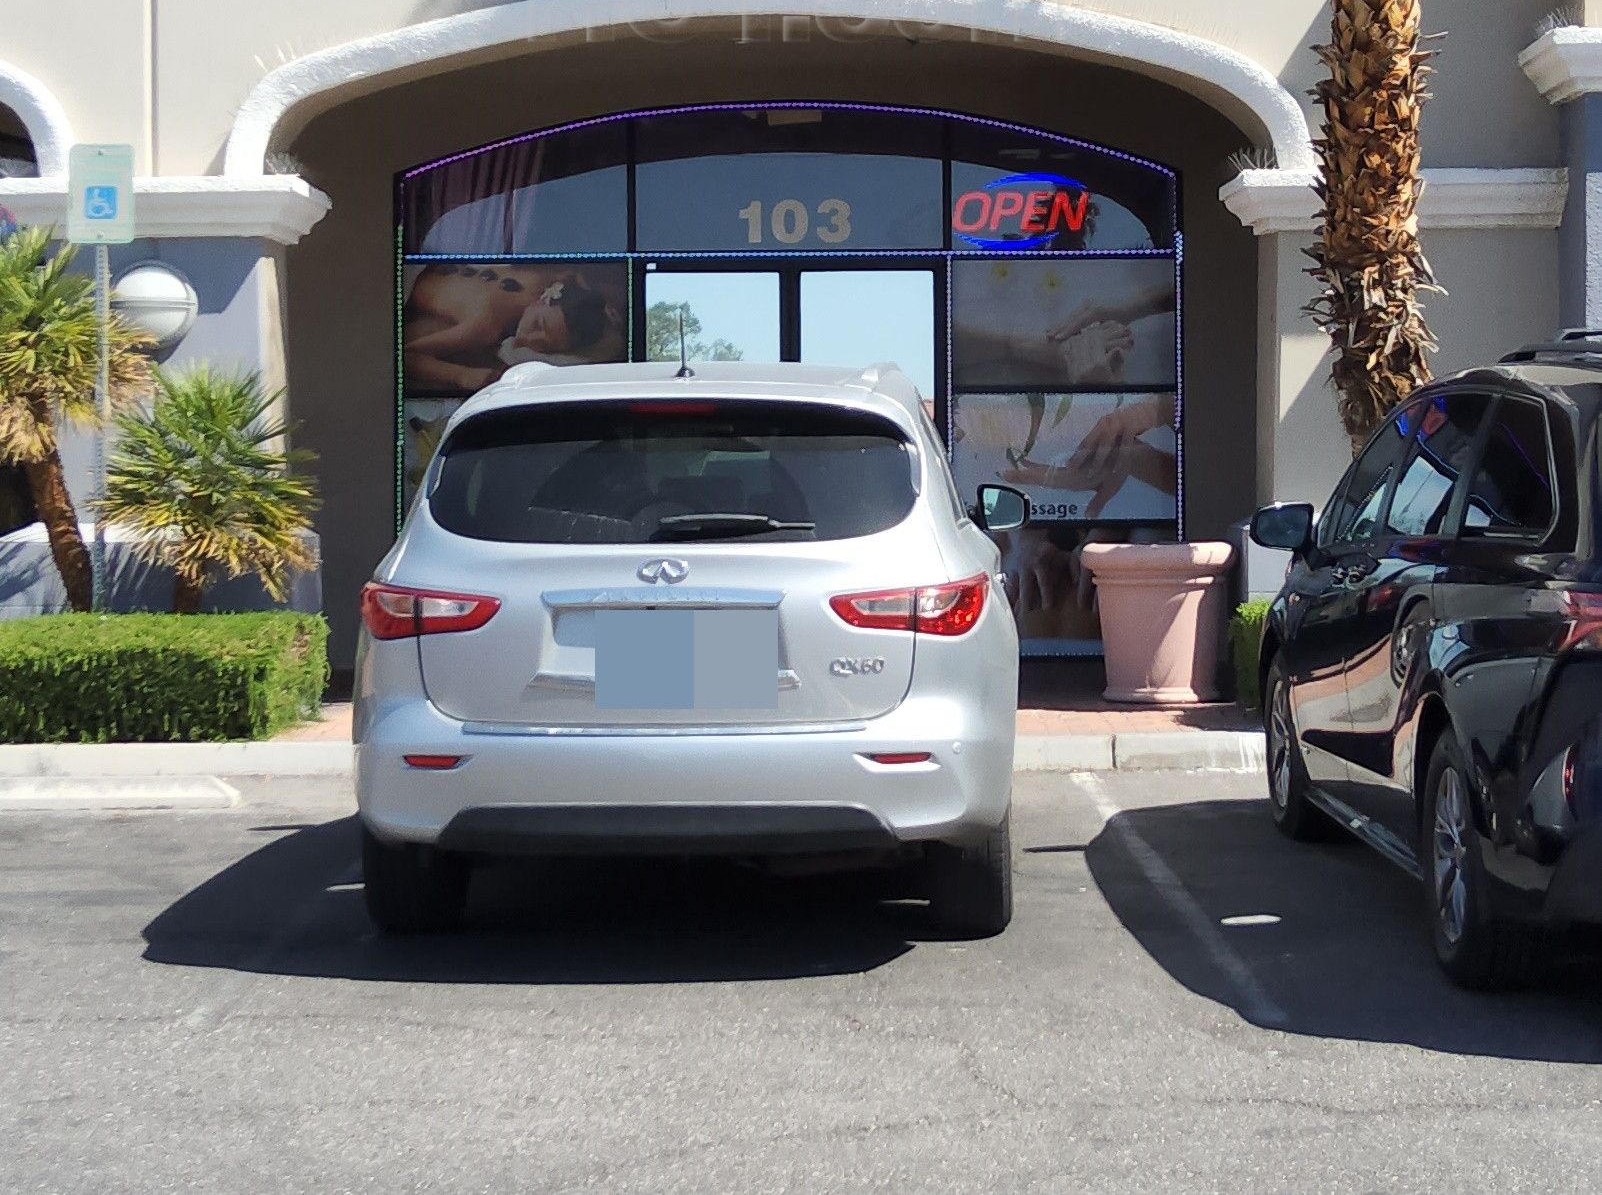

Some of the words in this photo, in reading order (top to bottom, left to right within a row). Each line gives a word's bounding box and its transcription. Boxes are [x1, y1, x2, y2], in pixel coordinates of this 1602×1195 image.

[739, 198, 851, 243] 103
[952, 191, 1088, 232] OPEN
[1031, 503, 1079, 518] ssage
[829, 657, 885, 677] QX60
